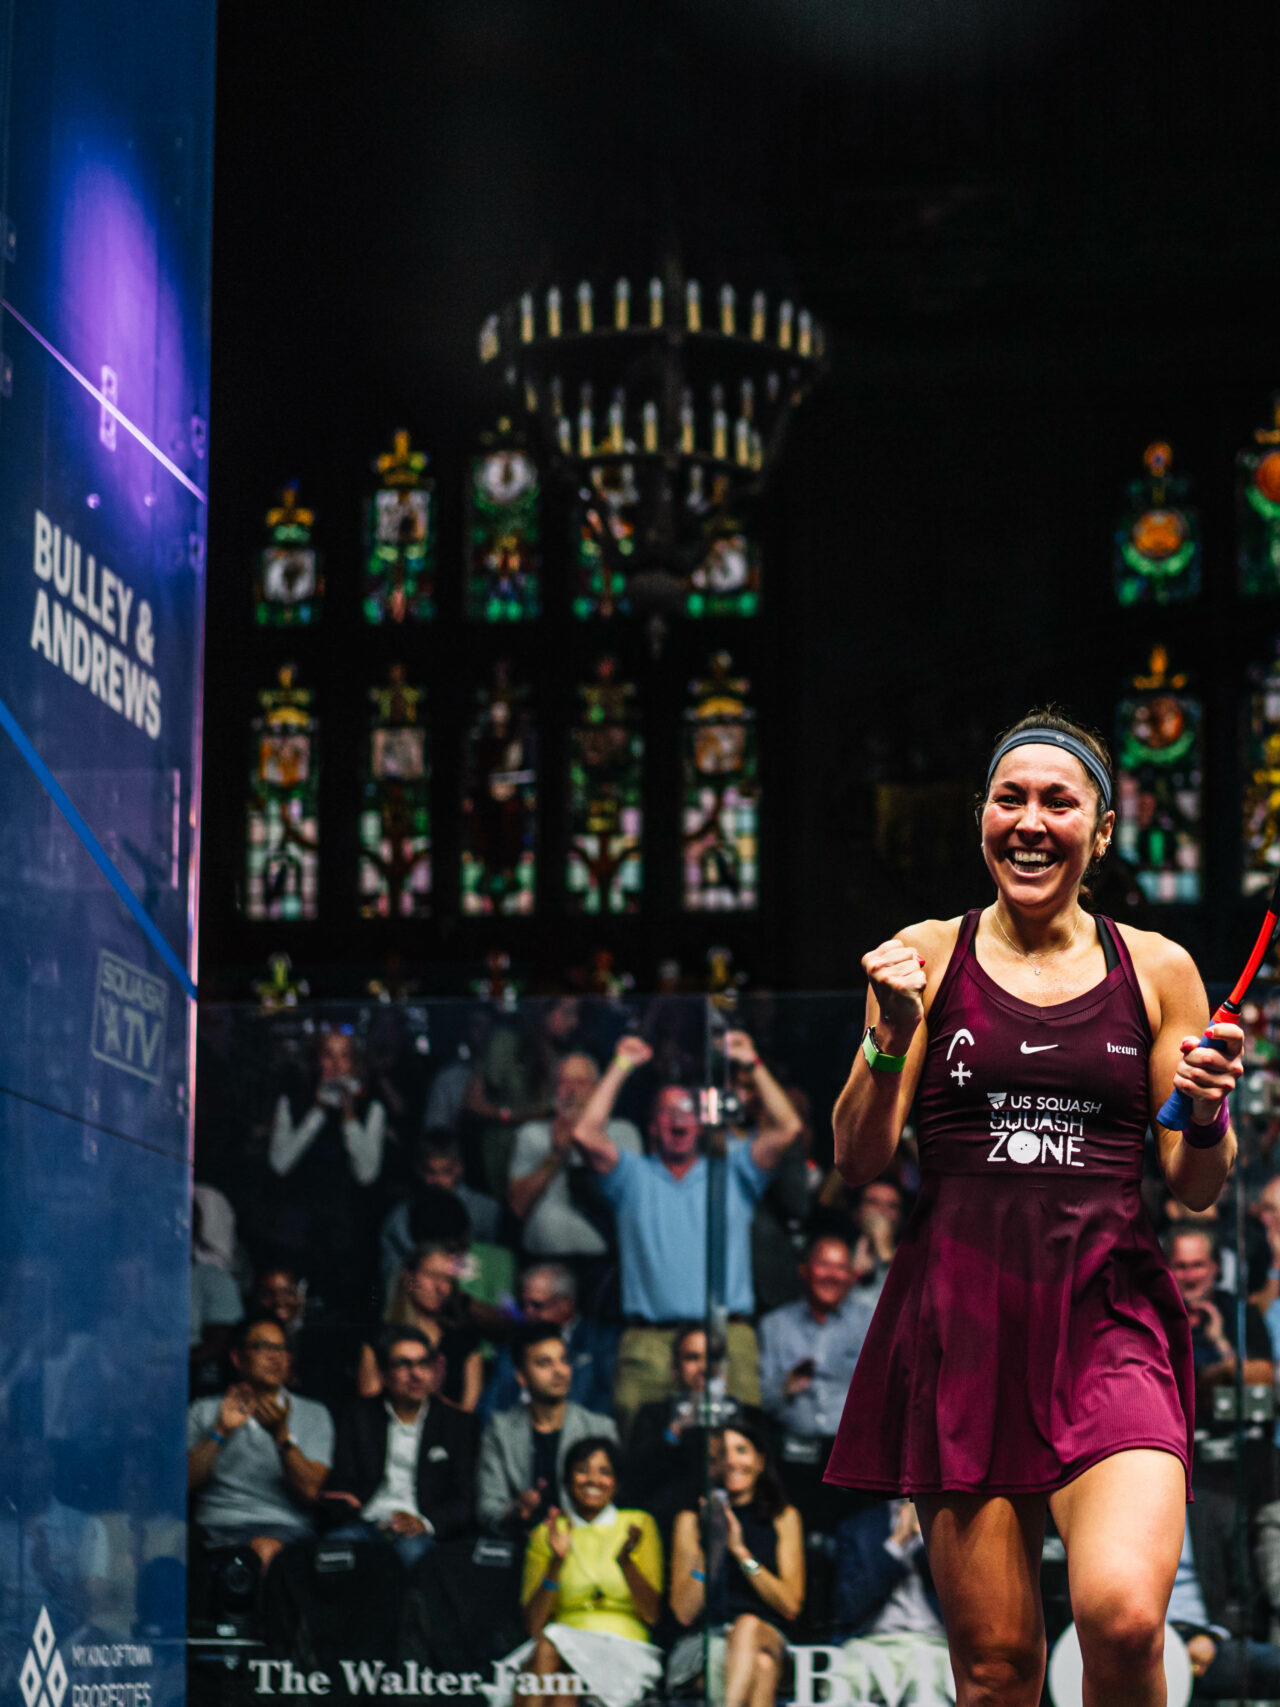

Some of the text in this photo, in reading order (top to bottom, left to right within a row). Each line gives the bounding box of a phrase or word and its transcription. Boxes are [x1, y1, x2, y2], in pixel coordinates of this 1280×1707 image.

[34, 509, 154, 667] BULLEY &
[31, 588, 162, 740] ANDREWS
[103, 961, 165, 1017] SQUASH
[123, 1007, 162, 1068] TV
[1106, 1042, 1138, 1056] beam
[990, 1111, 1085, 1136] SQUASH
[1010, 1096, 1102, 1114] US SQUASH
[987, 1130, 1086, 1167] ZONE
[72, 1681, 152, 1707] PROPERTIES
[248, 1658, 332, 1695] The
[339, 1658, 482, 1695] Walter
